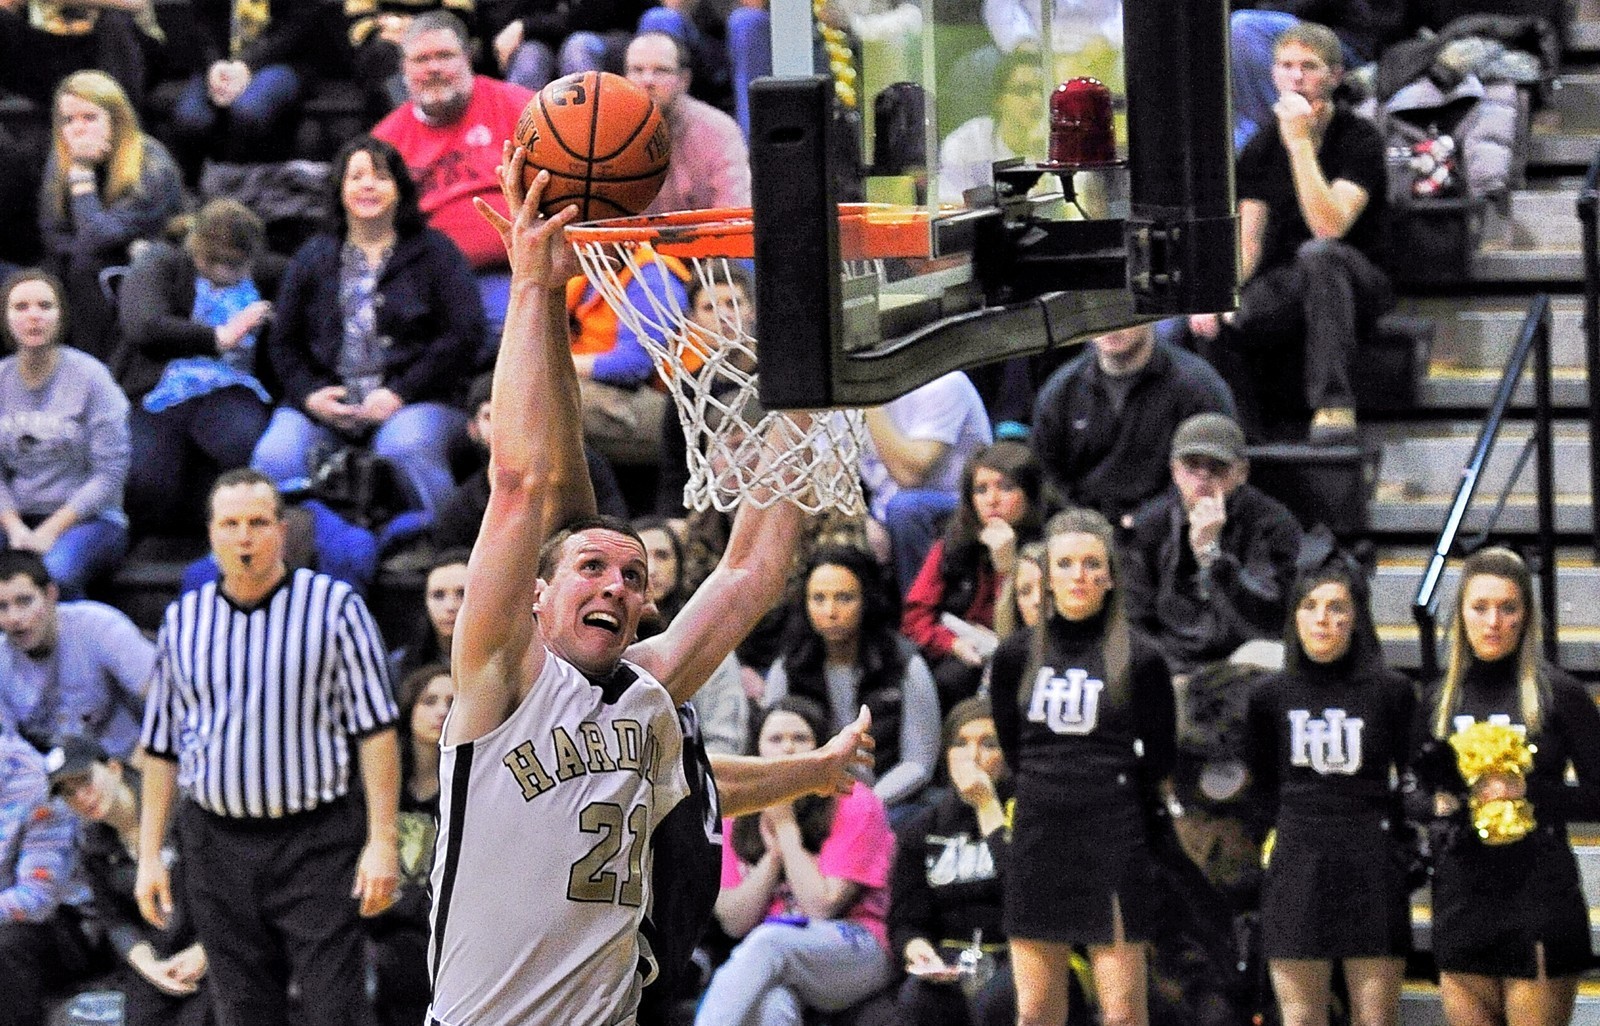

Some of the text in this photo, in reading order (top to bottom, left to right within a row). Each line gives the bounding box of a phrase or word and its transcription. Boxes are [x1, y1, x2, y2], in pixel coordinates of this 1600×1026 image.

[1027, 666, 1104, 735] HU
[1287, 708, 1364, 775] HU
[566, 801, 648, 907] 21
